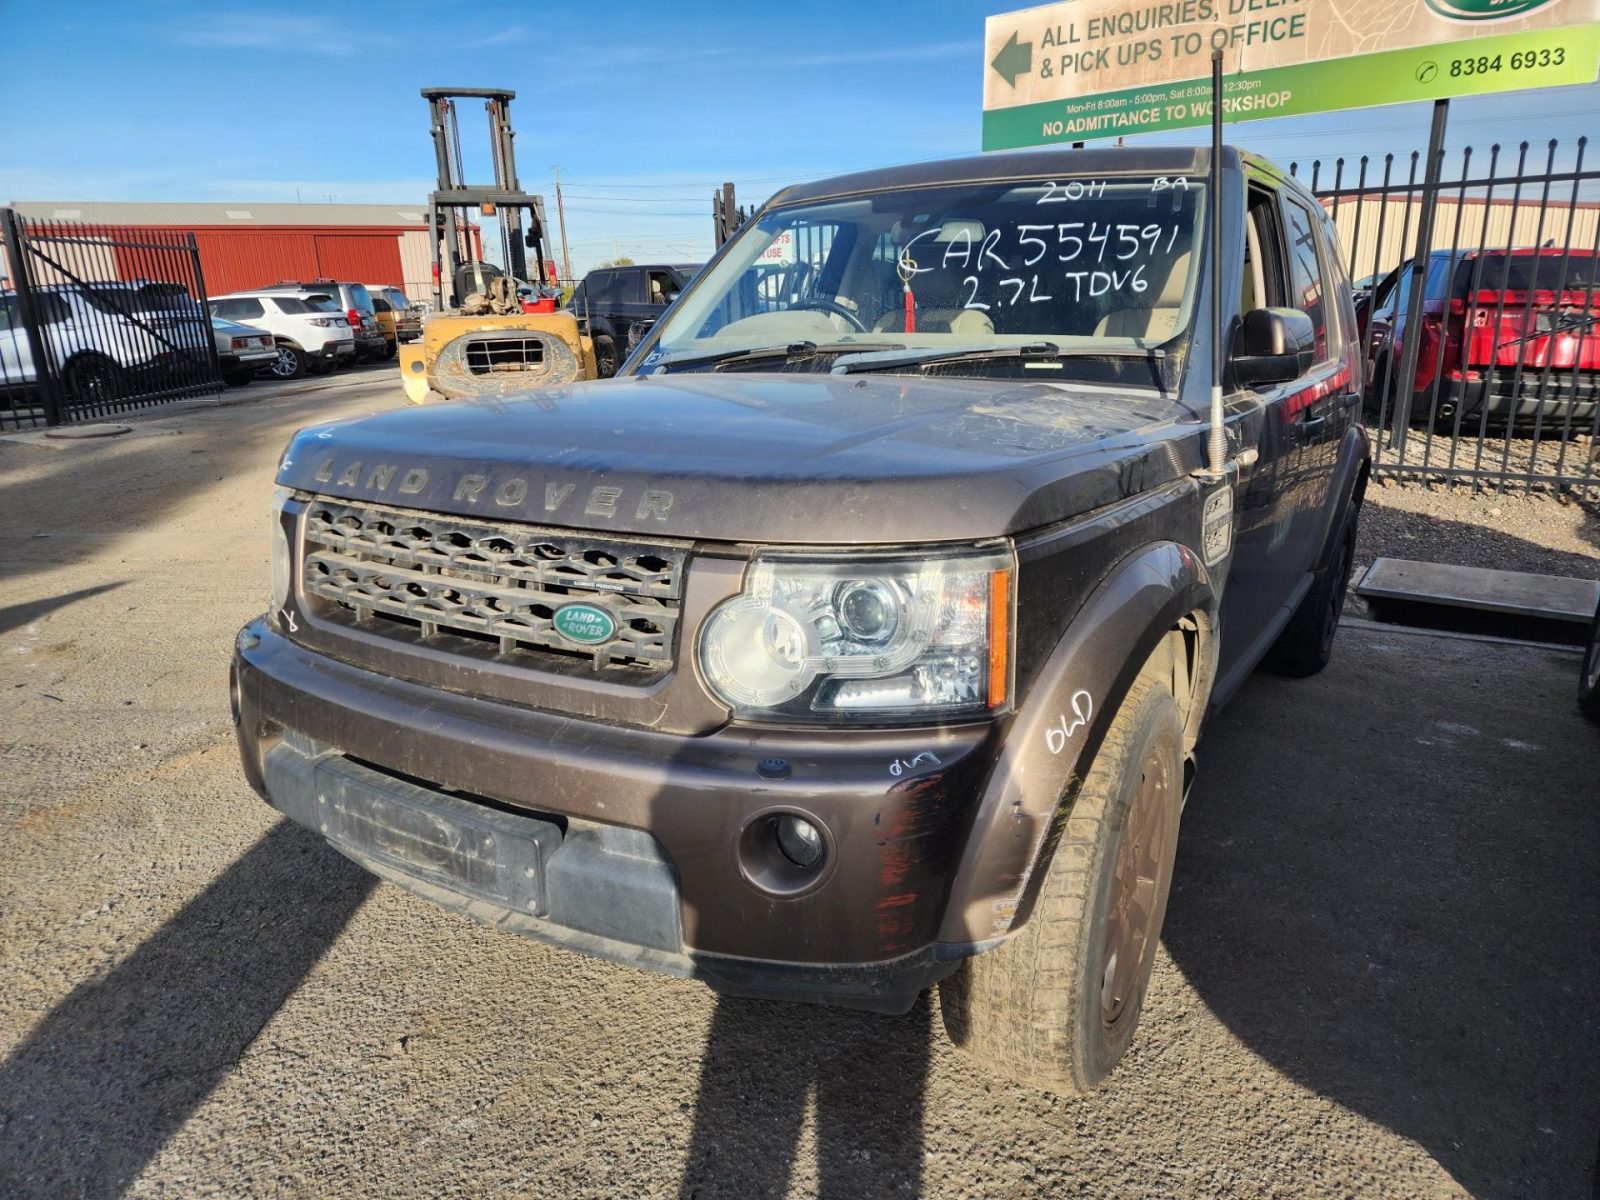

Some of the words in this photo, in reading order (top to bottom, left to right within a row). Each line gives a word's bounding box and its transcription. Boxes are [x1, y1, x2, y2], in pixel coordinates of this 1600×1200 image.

[1041, 23, 1081, 49] ALL
[1088, 0, 1220, 40] ENQUIRIES,
[1040, 58, 1054, 80] &
[1060, 46, 1111, 76] PICK
[1117, 38, 1162, 67] UPS
[1171, 32, 1203, 58] TO
[1210, 13, 1306, 52] OFFICE
[1450, 54, 1503, 78] 8384
[1510, 47, 1566, 71] 6933
[1066, 102, 1097, 114] Mon-Fri
[1097, 98, 1127, 110] 8:00am
[1170, 89, 1185, 99] Sat
[1186, 85, 1214, 97] 8:00a
[1043, 120, 1063, 137] NO
[1066, 105, 1161, 134] ADMITTANCE
[1165, 104, 1187, 121] TO
[1036, 181, 1106, 204] 2011
[899, 228, 1010, 272] CAR
[1017, 223, 1179, 266] 554591
[963, 275, 1053, 311] 2.7L
[1066, 265, 1148, 302] TDV6
[315, 458, 430, 495] LAND
[452, 473, 675, 521] ROVER
[565, 611, 595, 622] LAND
[568, 622, 604, 636] ROVER
